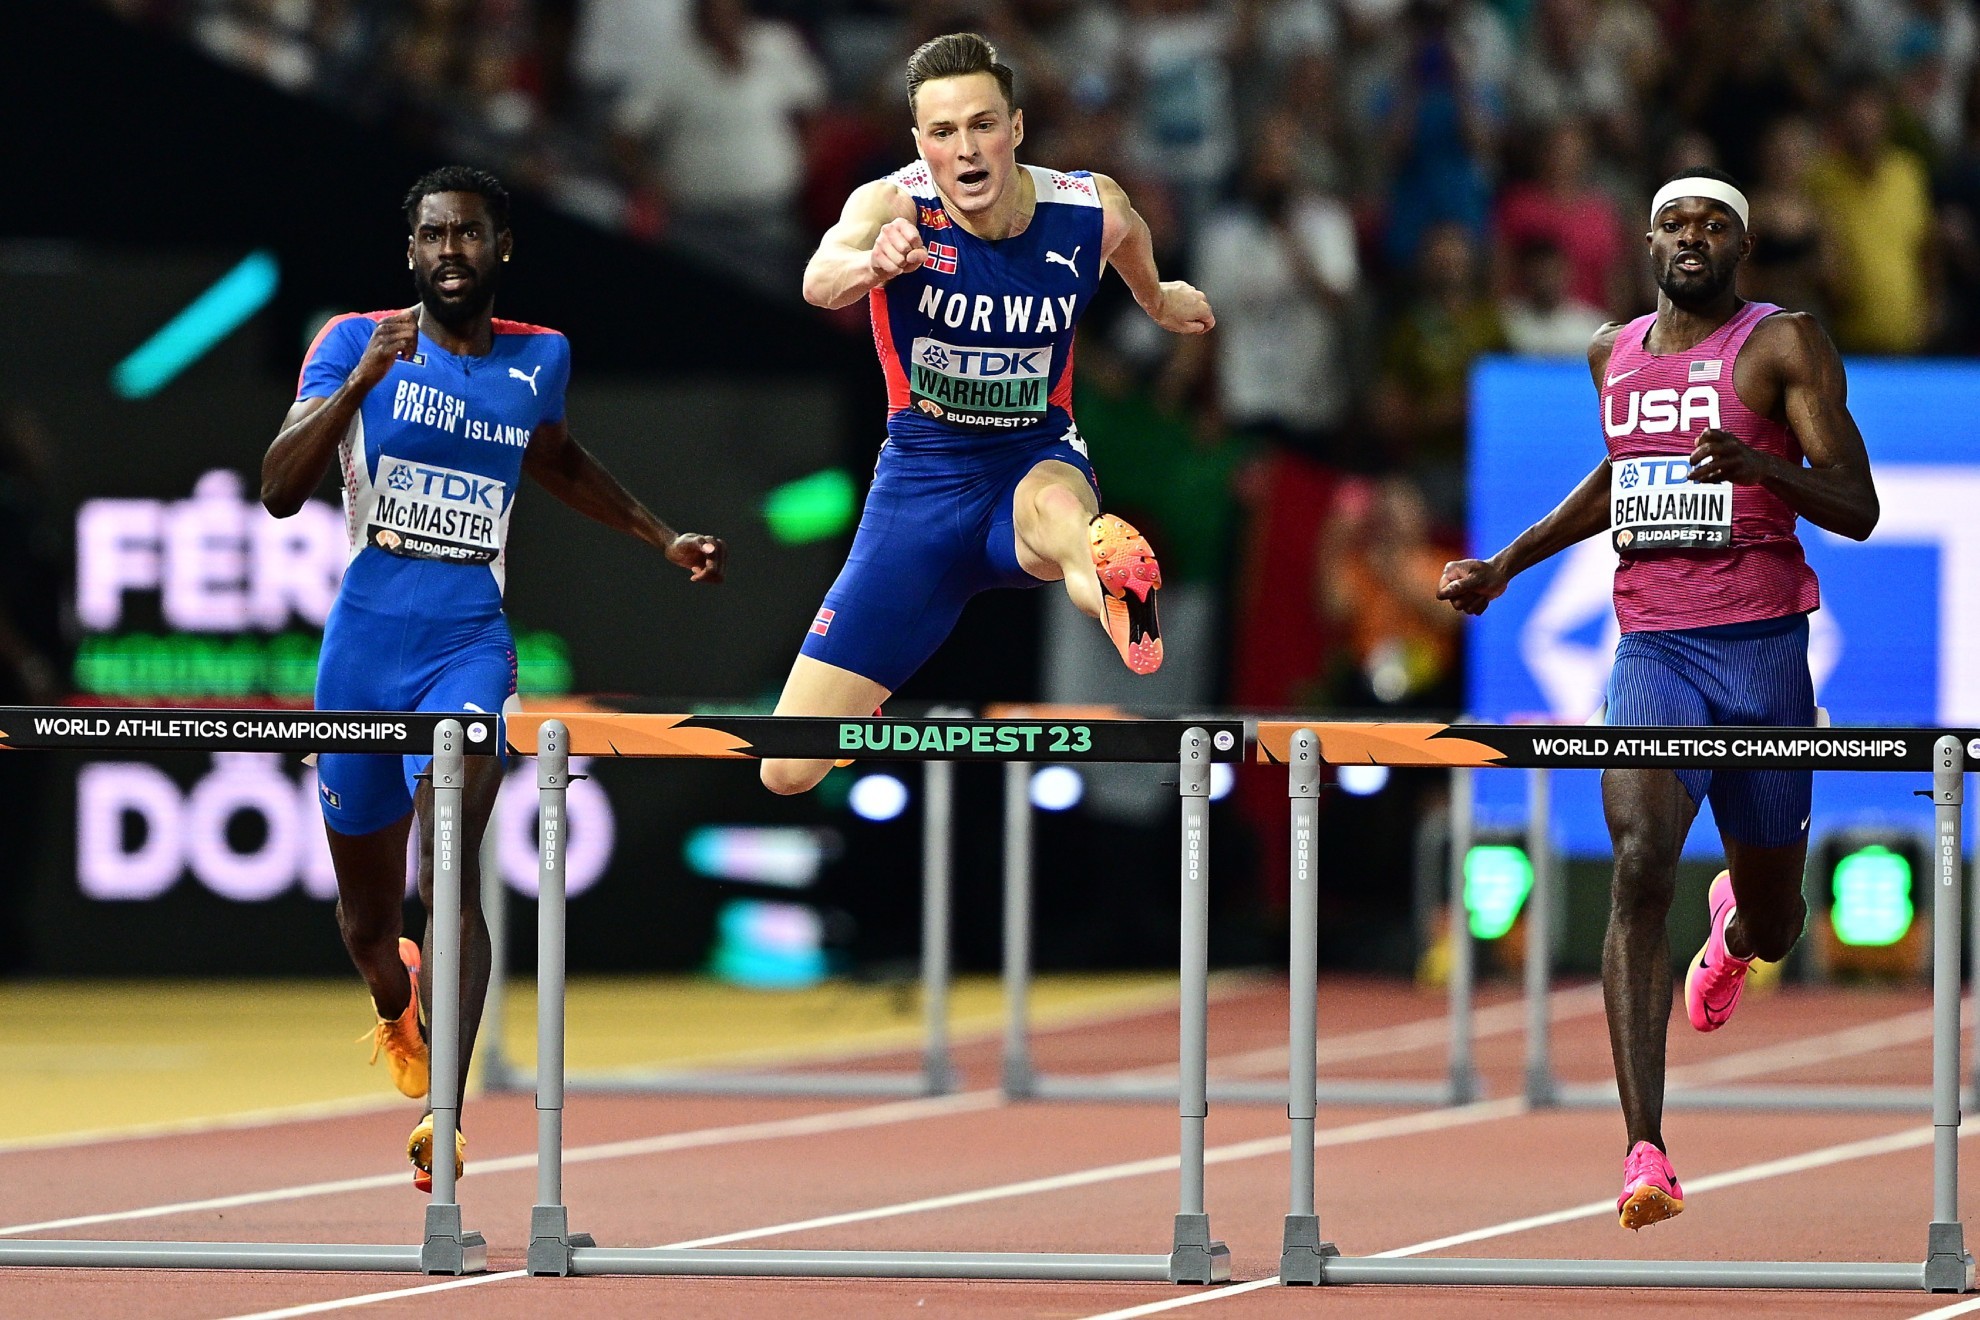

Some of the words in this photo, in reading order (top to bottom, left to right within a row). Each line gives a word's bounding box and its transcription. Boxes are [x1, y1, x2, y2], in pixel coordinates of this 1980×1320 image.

[917, 284, 1078, 334] NORWAY
[949, 349, 1043, 376] TDK
[395, 379, 466, 419] BRITISH
[916, 366, 1040, 408] WARHOLM
[392, 400, 457, 434] VIRGIN
[464, 419, 531, 449] ISLANDS
[946, 411, 1021, 428] BUDAPEST
[1604, 385, 1722, 438] USA
[415, 467, 495, 511] TDK
[1640, 459, 1722, 486] TD
[375, 495, 494, 544] McMASTER
[1614, 493, 1725, 526] BENJAMIN
[404, 538, 476, 559] BUDAPEST
[1636, 529, 1706, 542] BUDAPEST
[1706, 530, 1723, 542] 23
[34, 718, 111, 737] WORLD
[115, 719, 228, 739] ATHLETICS
[231, 720, 408, 741] CHAMPIONSHIPS
[838, 723, 1044, 753] BUDAPEST
[1048, 725, 1093, 753] 23
[1532, 738, 1609, 757] WORLD
[1613, 738, 1727, 757] ATHLETICS
[1730, 739, 1908, 758] CHAMPIONSHIPS
[440, 820, 453, 871] MONDO
[544, 820, 558, 871] MONDO
[1187, 829, 1201, 880] MONDO
[1296, 829, 1310, 880] MONDO
[1941, 835, 1955, 886] MONDO
